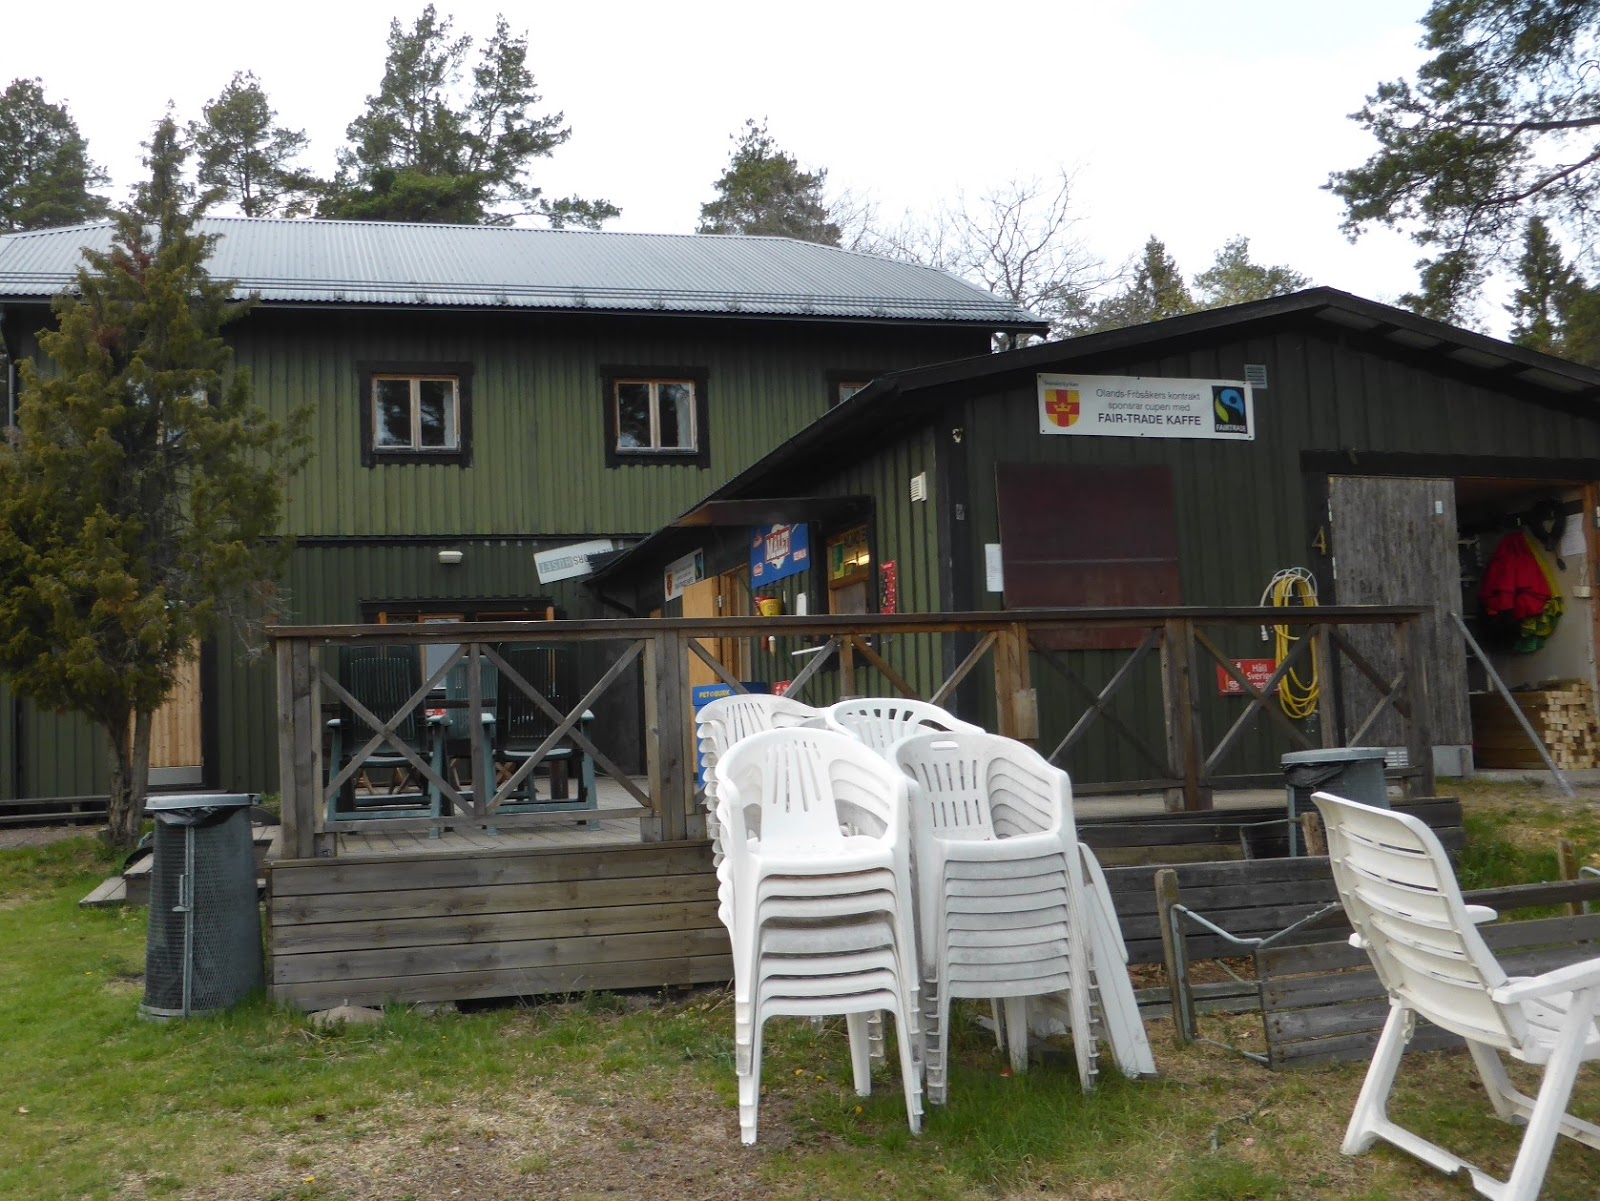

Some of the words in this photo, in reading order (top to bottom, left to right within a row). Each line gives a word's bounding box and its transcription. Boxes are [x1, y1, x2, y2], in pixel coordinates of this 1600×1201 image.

[1167, 392, 1200, 401] kontrakt
[1108, 402, 1143, 410] sponsrar
[1145, 403, 1171, 412] cupen
[1098, 413, 1163, 424] FAIR-TRADE
[1166, 415, 1201, 425] KAFFE
[1216, 424, 1246, 432] FAIRTRADE
